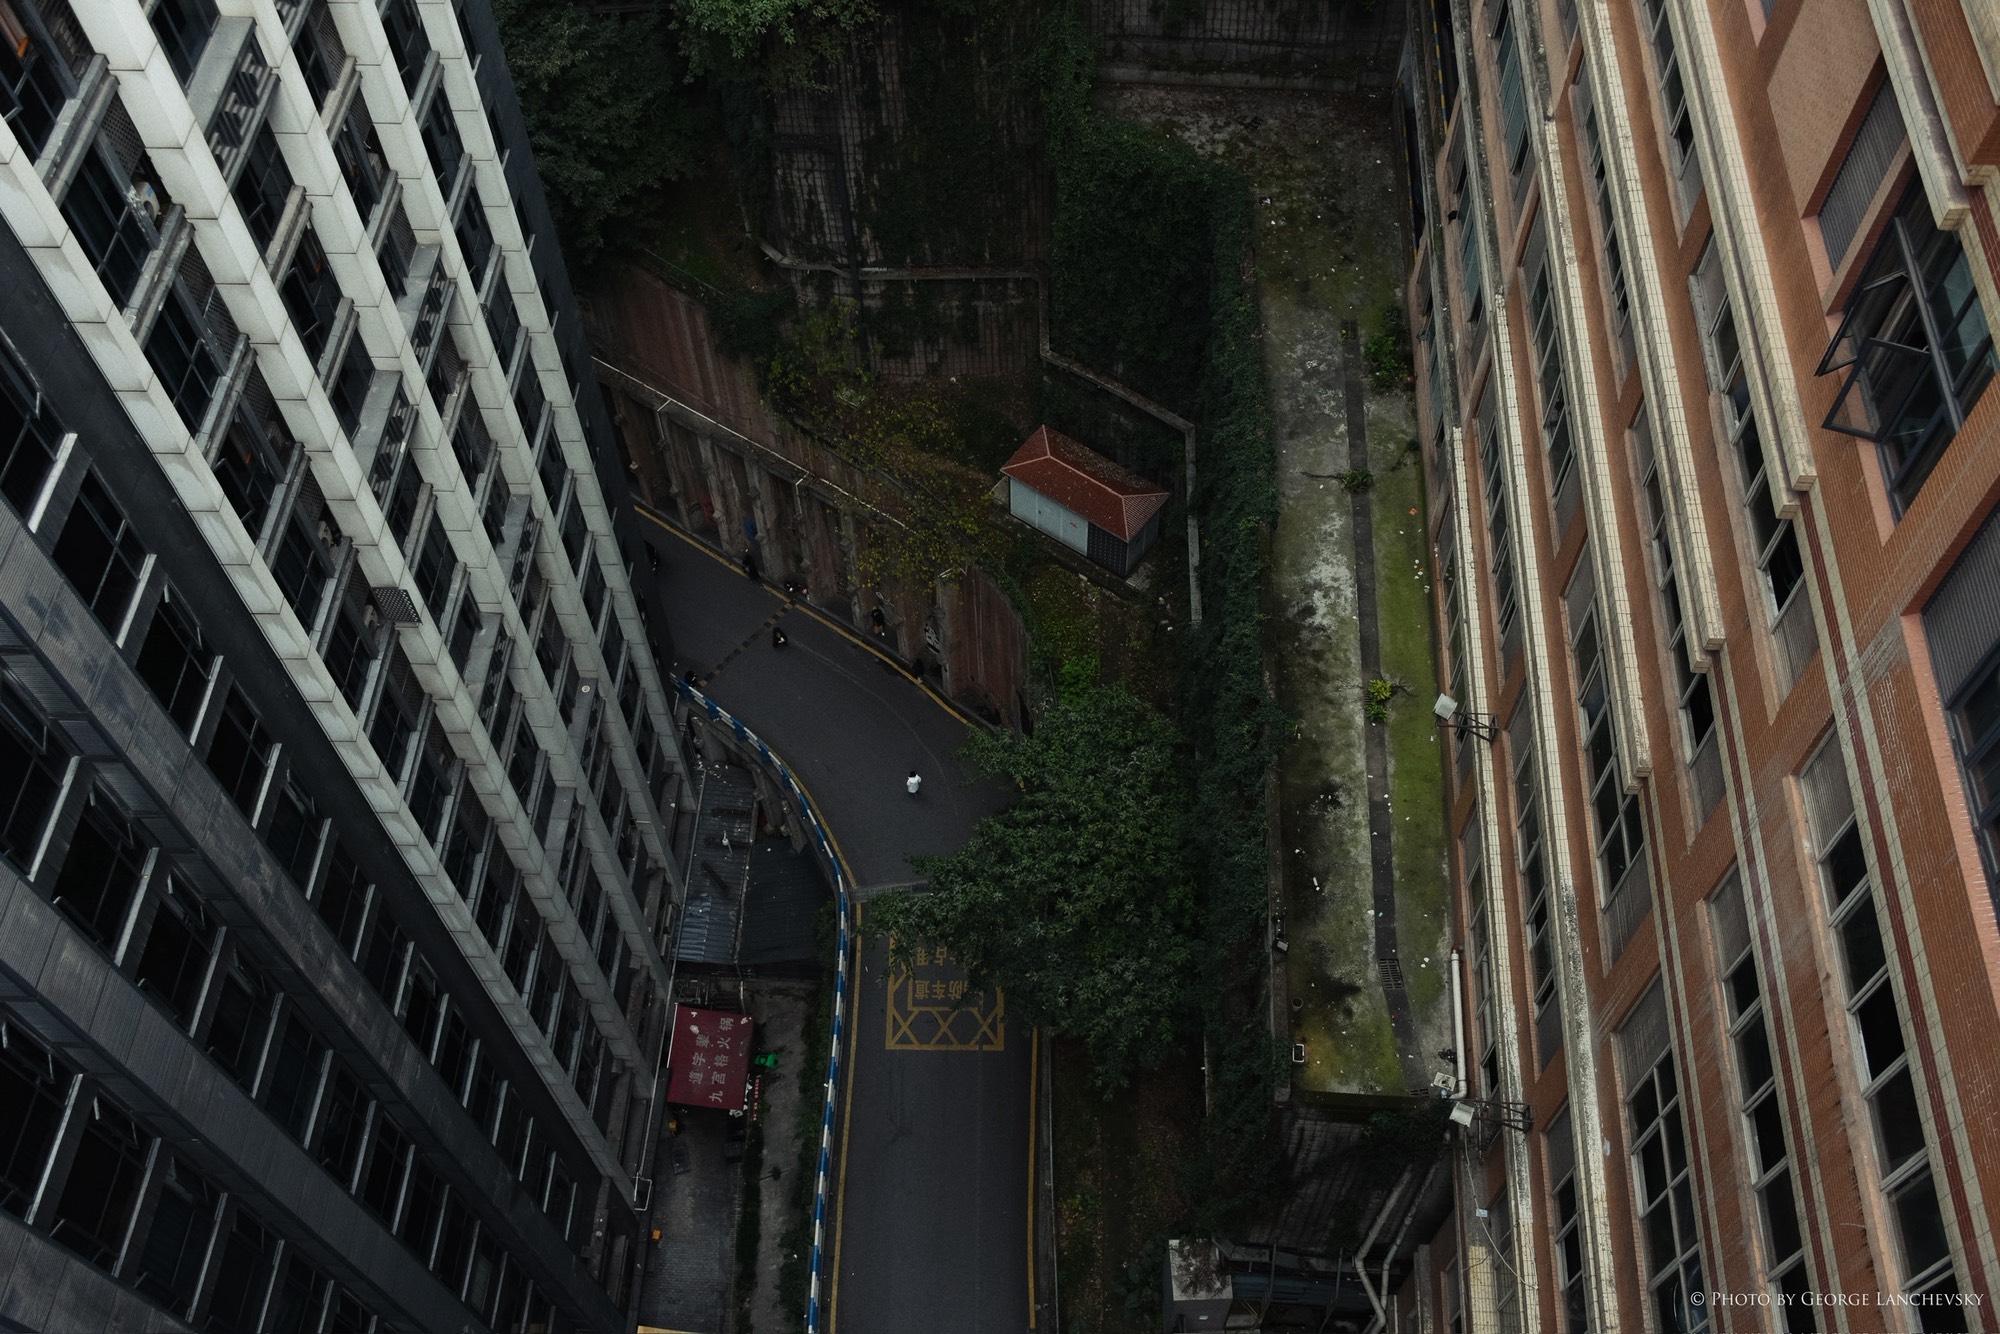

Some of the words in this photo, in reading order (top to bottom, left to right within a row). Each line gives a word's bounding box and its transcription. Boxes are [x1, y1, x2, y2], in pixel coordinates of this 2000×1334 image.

[708, 1017, 734, 1103] 九宫格火锅
